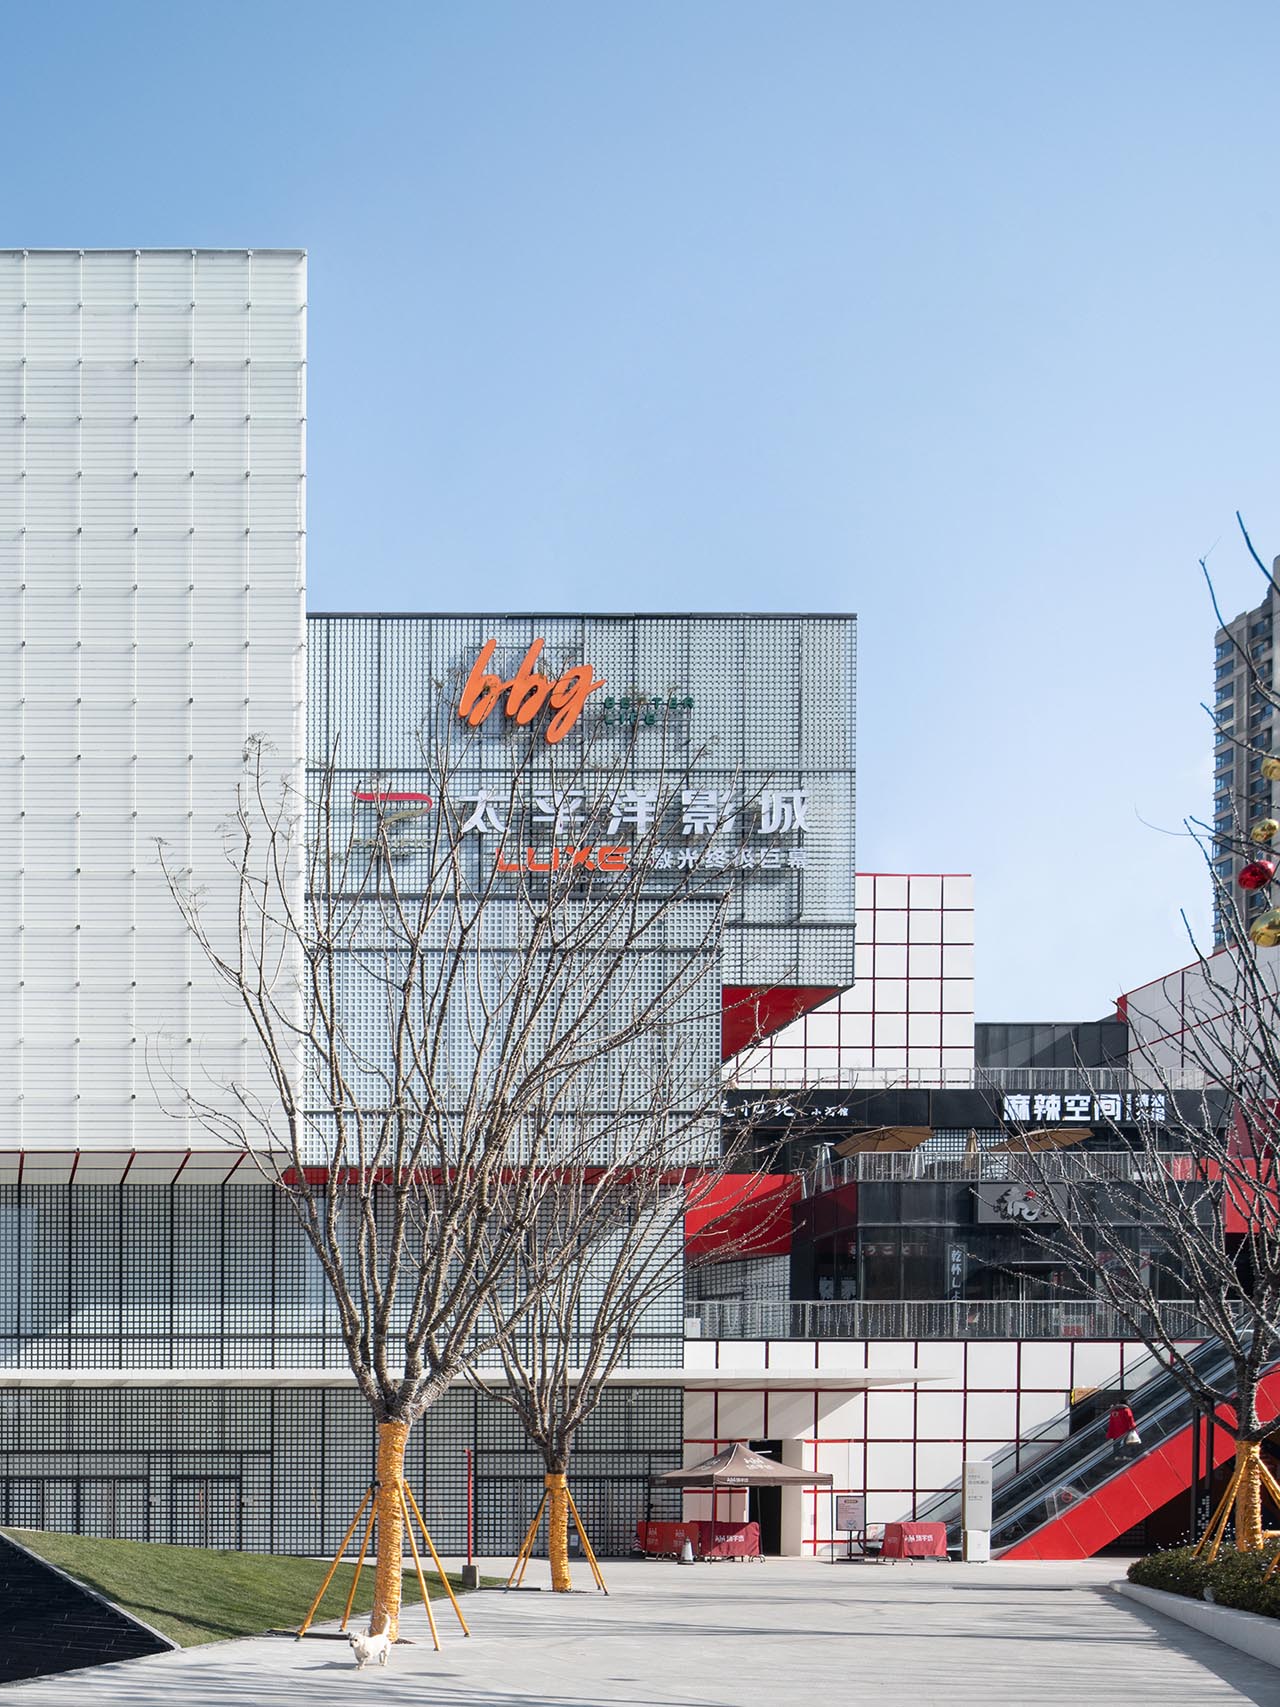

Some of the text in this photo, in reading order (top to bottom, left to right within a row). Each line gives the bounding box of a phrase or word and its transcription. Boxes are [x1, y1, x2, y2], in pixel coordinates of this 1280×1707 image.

[458, 638, 607, 745] bbg
[604, 696, 695, 710] BETER
[604, 712, 656, 726] LIFE
[458, 788, 811, 835] 太平洋影城
[495, 845, 632, 872] LUXE
[1002, 1093, 1122, 1122] 麻辣空间
